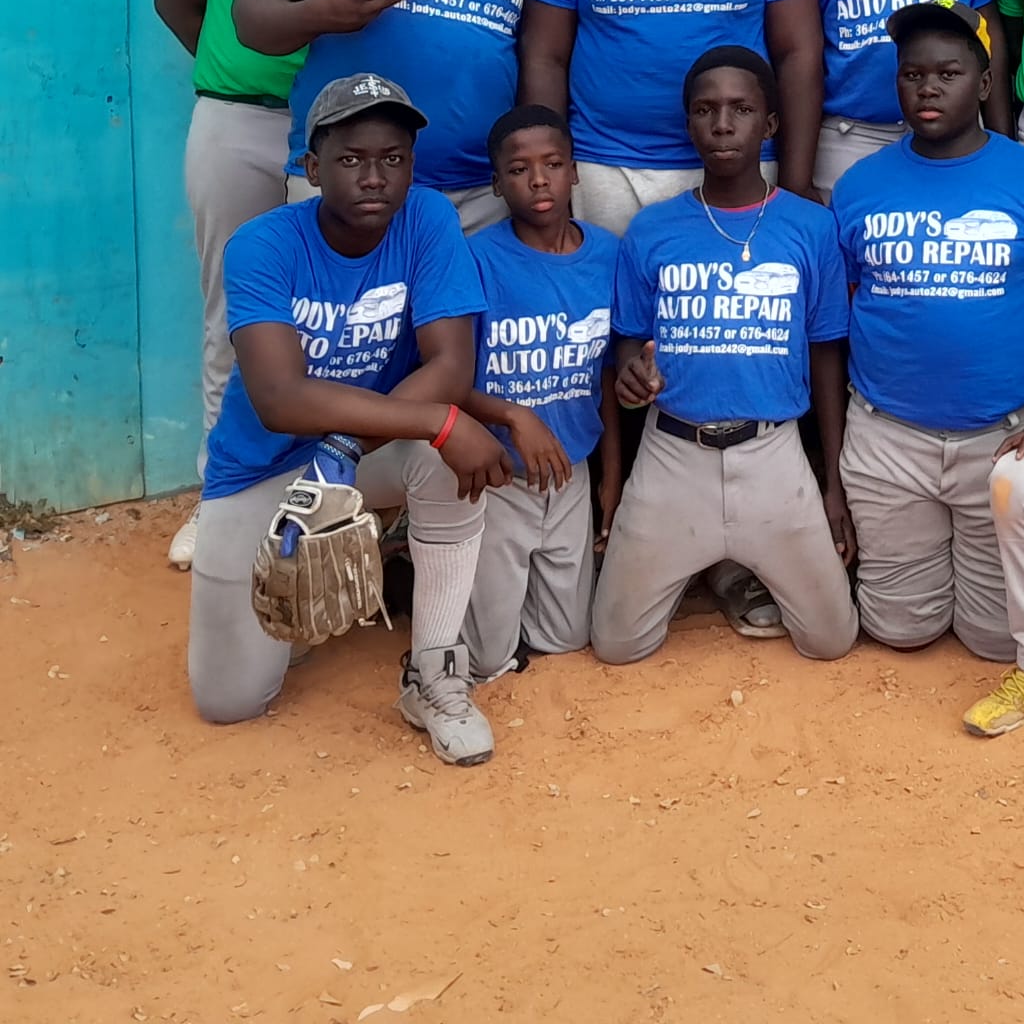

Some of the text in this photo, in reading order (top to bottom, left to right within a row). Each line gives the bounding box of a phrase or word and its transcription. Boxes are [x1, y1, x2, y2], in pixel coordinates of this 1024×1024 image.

[468, 1, 481, 13] or
[864, 210, 942, 241] JODY'S
[864, 240, 1011, 267] AUTO REPAIR
[933, 272, 947, 283] or
[950, 270, 1007, 285] 676-4624
[657, 294, 792, 322] AUTO REPAIR
[486, 312, 568, 348] JODY'S
[670, 326, 721, 340] 364-1457
[723, 329, 737, 340] or
[486, 348, 546, 376] AUTO
[486, 380, 504, 395] Ph:
